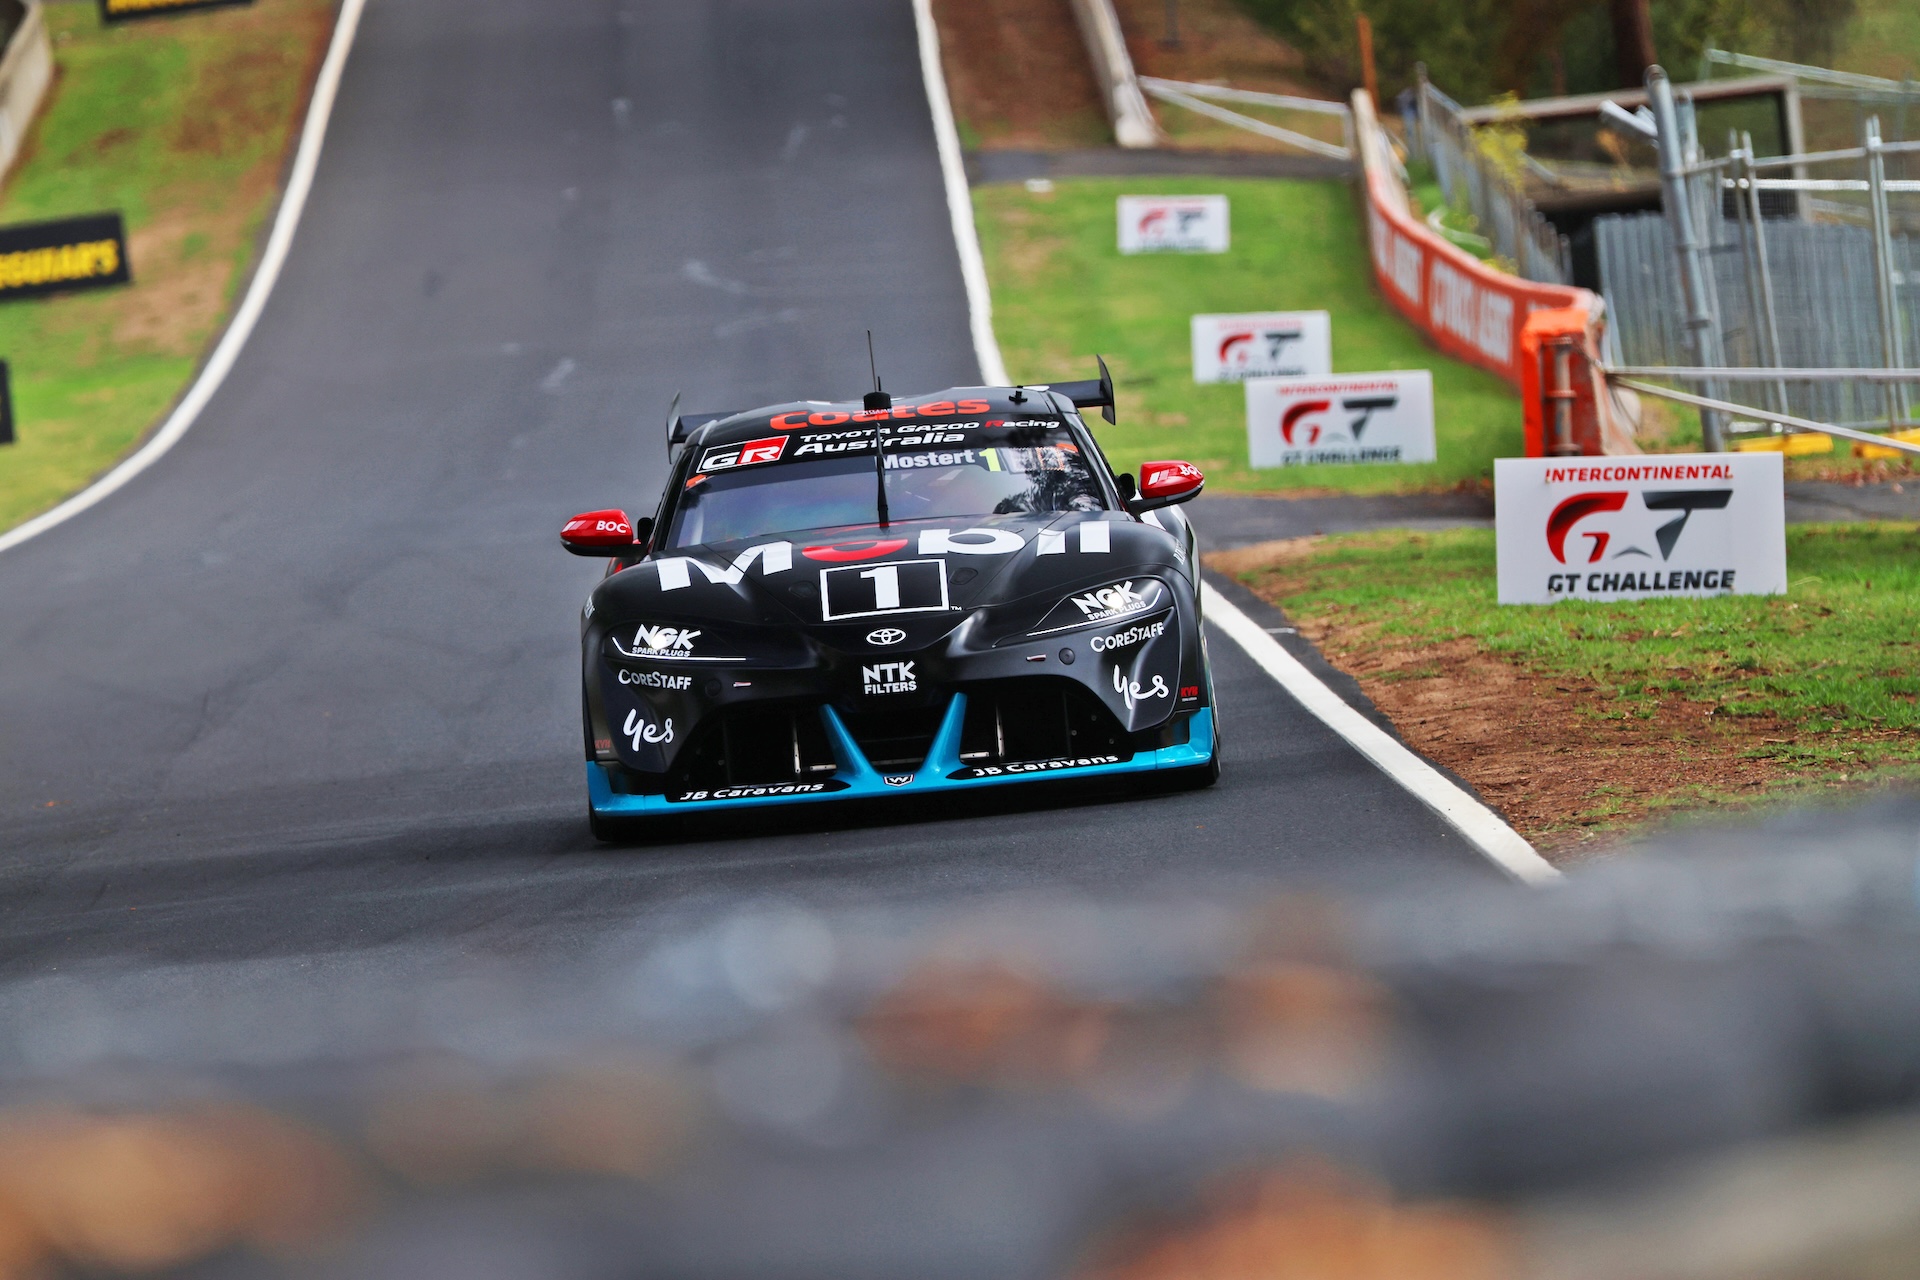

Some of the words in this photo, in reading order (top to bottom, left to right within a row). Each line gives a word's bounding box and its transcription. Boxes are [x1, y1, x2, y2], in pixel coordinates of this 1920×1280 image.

[769, 400, 990, 431] Coates
[800, 427, 892, 442] TOYOTA
[897, 421, 980, 434] GAZOO
[984, 420, 1060, 429] Racing
[793, 432, 965, 457] Australia
[702, 446, 780, 470] GR
[875, 449, 976, 470] Mostert
[1545, 465, 1733, 483] INTERCONTINENTAL
[596, 521, 627, 533] BOC
[656, 520, 1110, 591] Mobil
[860, 565, 900, 609] 1
[1548, 574, 1581, 593] GT
[1587, 570, 1736, 591] CHALLENGE
[1071, 581, 1142, 614] NGK
[1119, 600, 1147, 613] PLUGS
[633, 624, 701, 650] NGK
[632, 646, 659, 656] SPARK
[660, 648, 691, 657] PLUGS
[862, 660, 916, 684] NTK
[864, 680, 917, 695] FILTERS
[973, 765, 1003, 777] JB
[1007, 753, 1119, 772] Caravans
[680, 790, 708, 800] JB
[713, 783, 825, 798] Caravans
